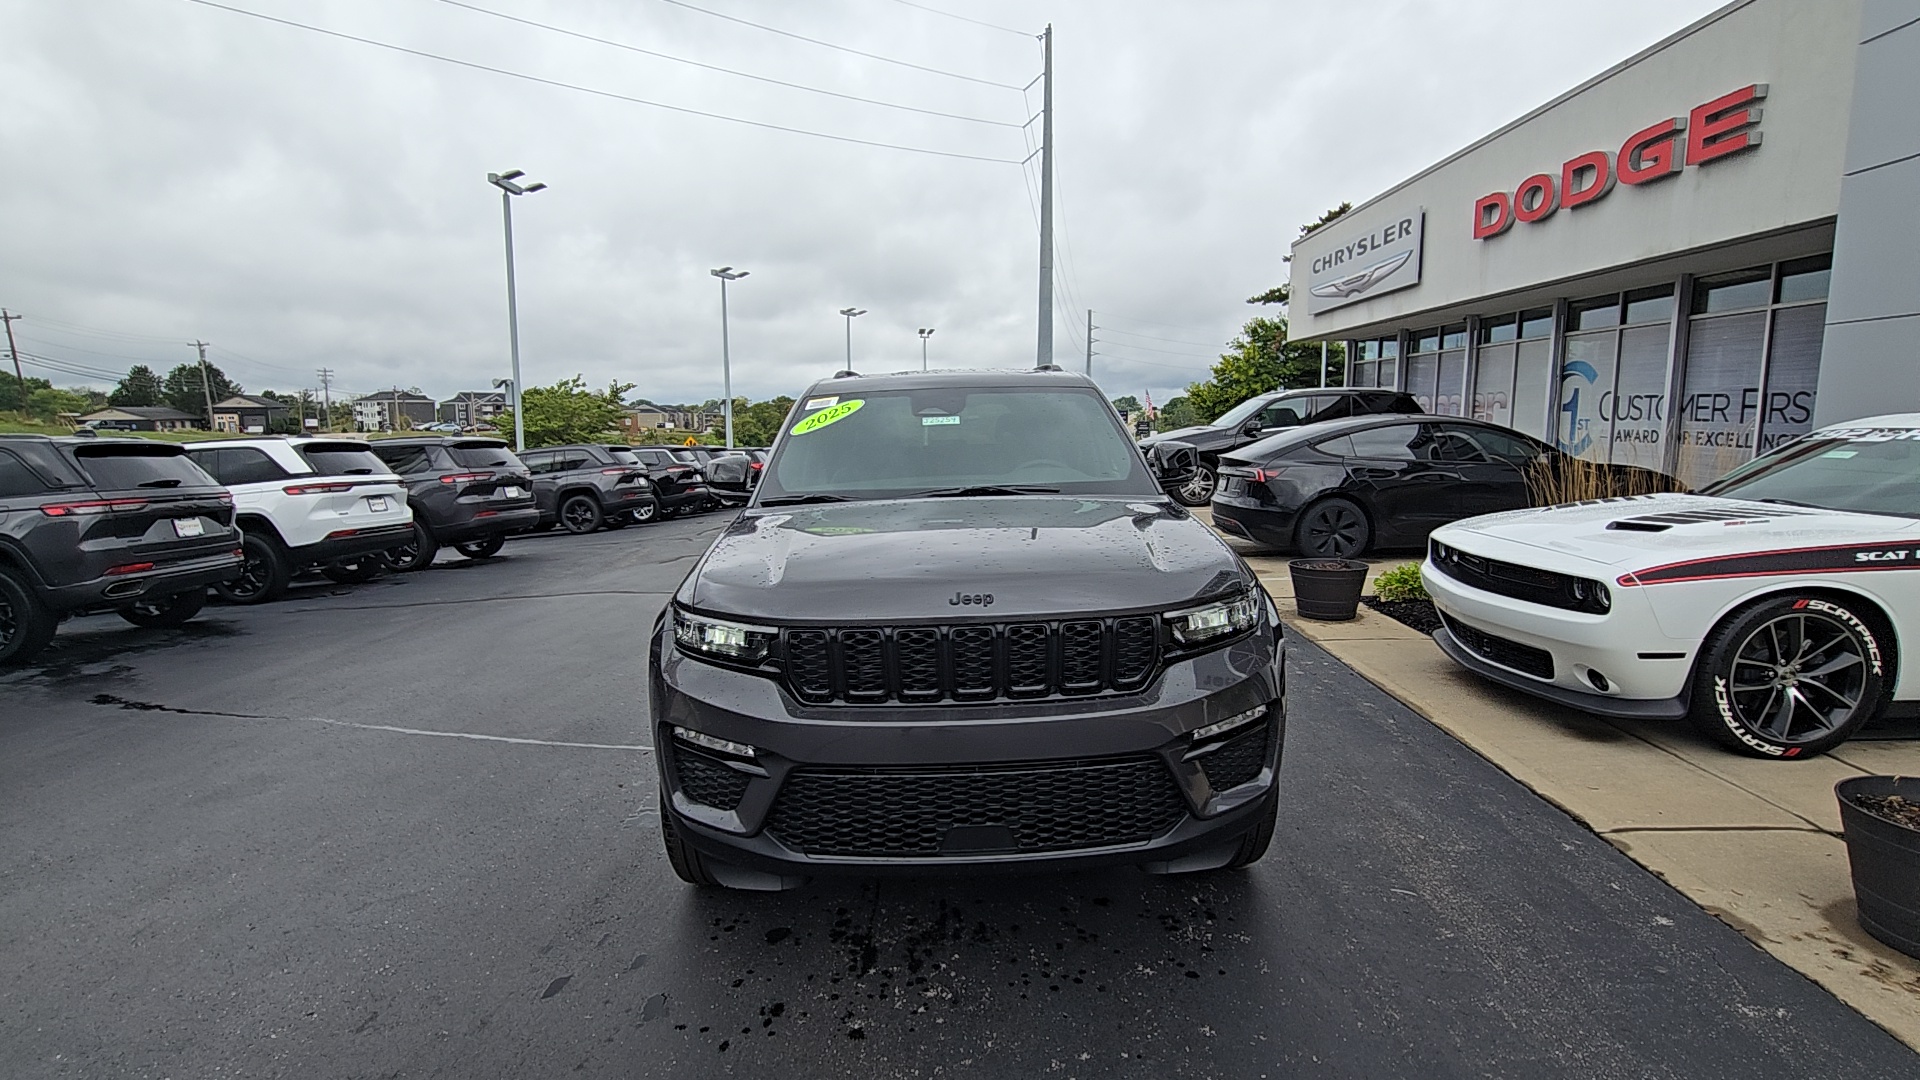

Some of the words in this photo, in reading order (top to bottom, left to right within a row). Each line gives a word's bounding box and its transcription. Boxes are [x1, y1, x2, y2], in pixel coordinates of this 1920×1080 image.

[1473, 84, 1768, 240] DODGE
[1312, 218, 1412, 274] CHRYSLER
[805, 402, 852, 431] 2025
[1739, 388, 1817, 424] FIRS
[1615, 429, 1660, 444] AWARD
[1855, 550, 1910, 562] SCAT
[949, 591, 994, 607] Jeep
